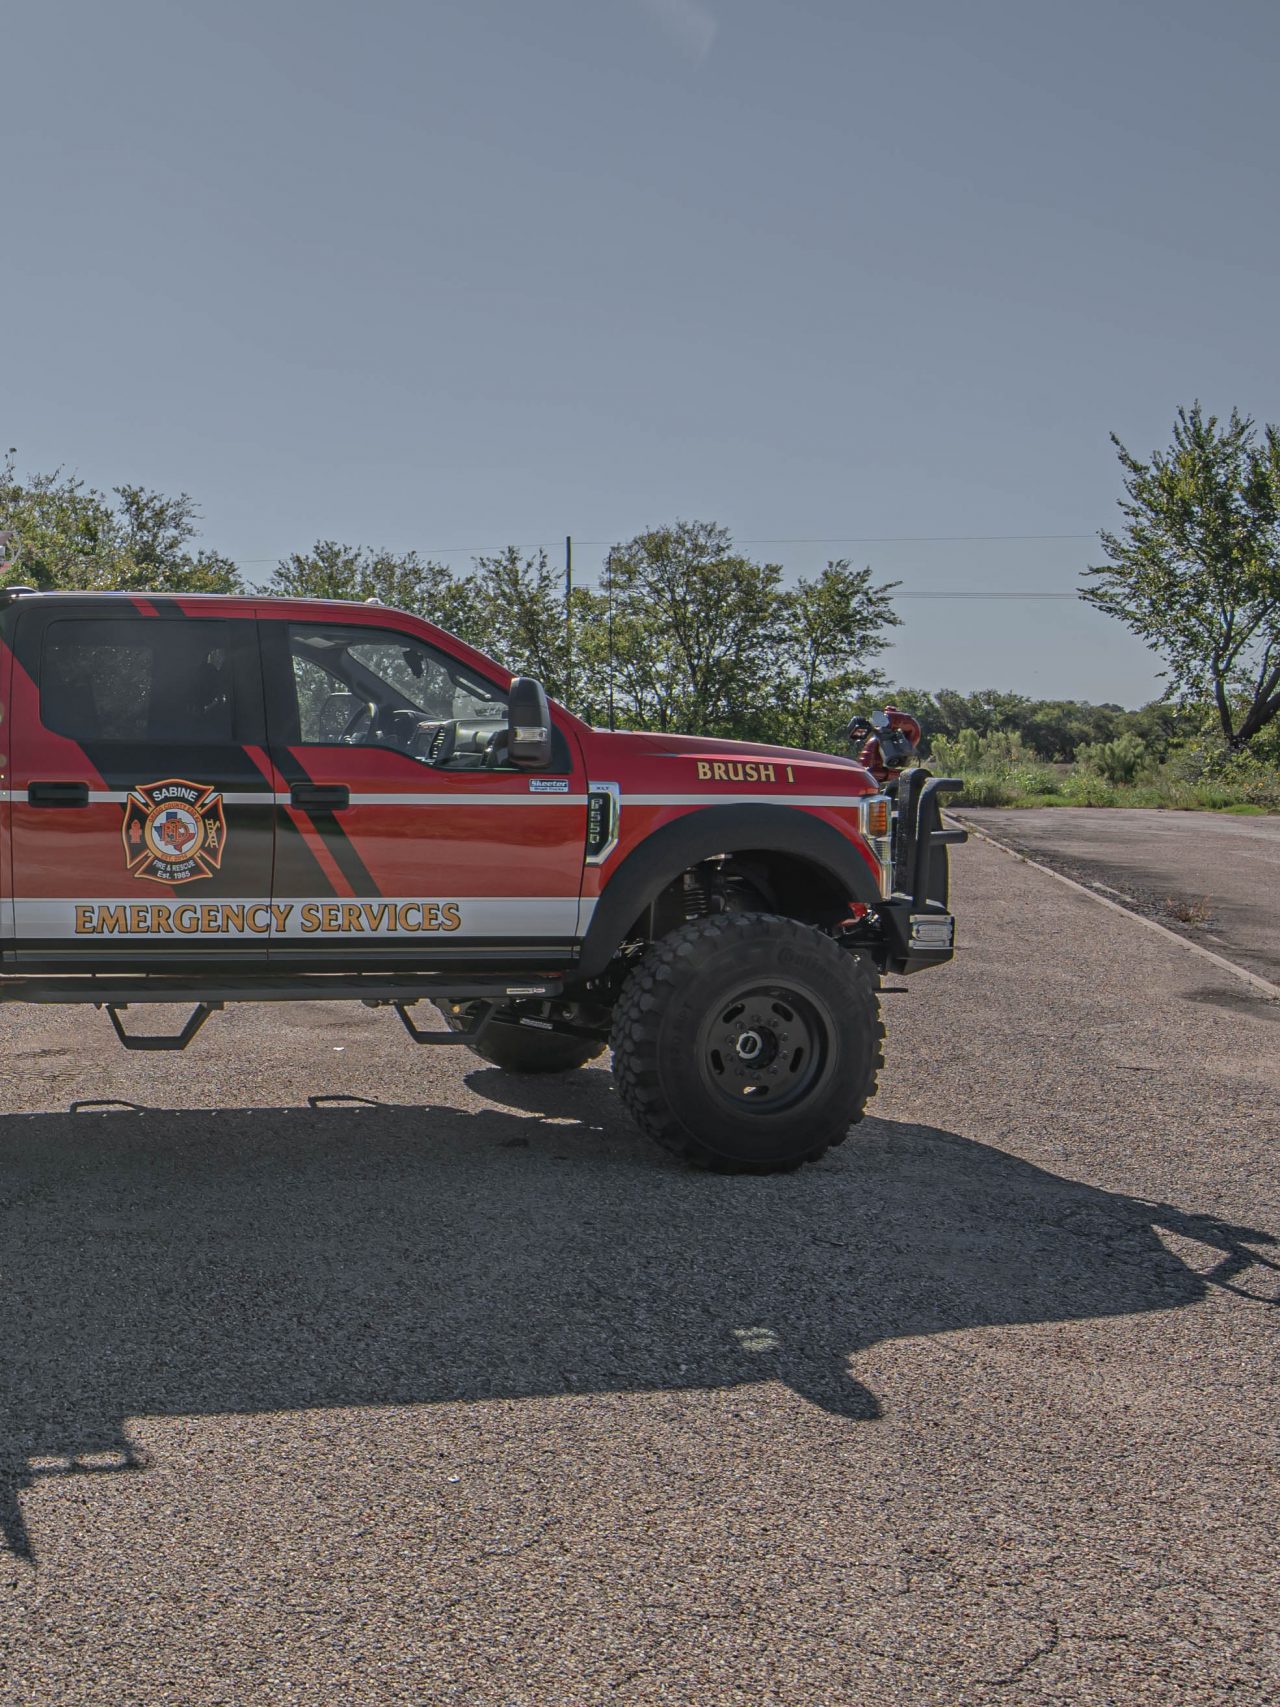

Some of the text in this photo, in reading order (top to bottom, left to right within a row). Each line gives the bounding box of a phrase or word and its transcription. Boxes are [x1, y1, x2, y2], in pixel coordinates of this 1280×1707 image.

[697, 761, 776, 782] BRUSH
[152, 786, 197, 801] SABINE
[152, 860, 166, 870] FIRE
[172, 860, 196, 872] RESCUE
[157, 870, 191, 880] Est. 1985
[75, 903, 462, 934] EMERGENCY SERVICES
